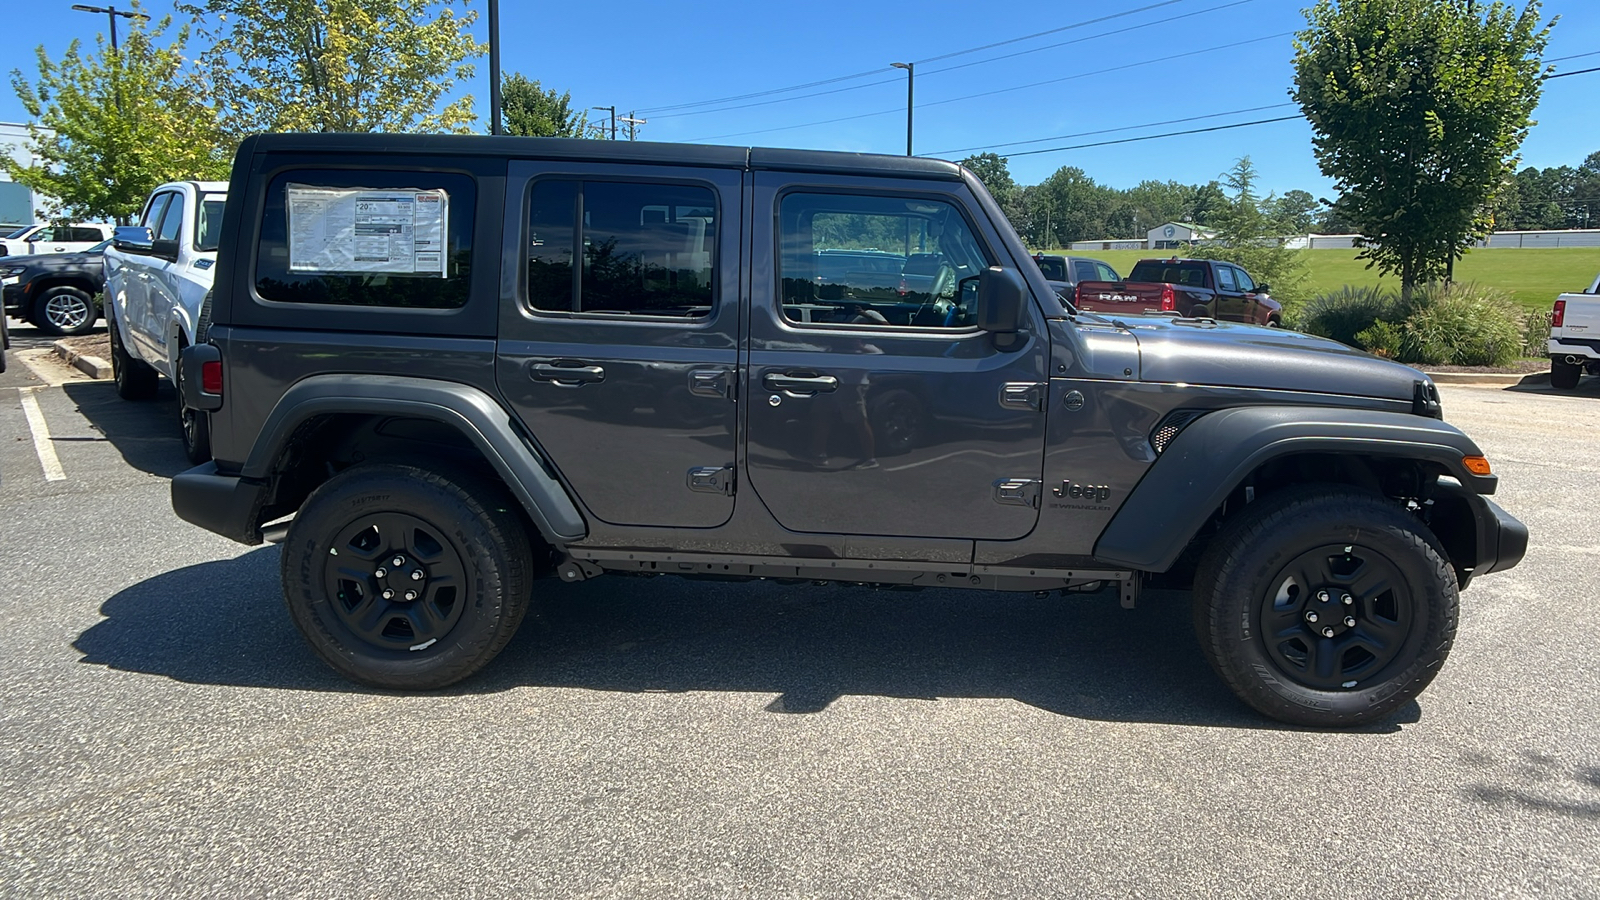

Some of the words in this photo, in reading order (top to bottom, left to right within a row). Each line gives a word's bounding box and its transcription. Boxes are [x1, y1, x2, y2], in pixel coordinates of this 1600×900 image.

[1098, 293, 1138, 302] RAM
[1052, 479, 1111, 503] Jeep
[1059, 503, 1111, 511] WRANGLER
[455, 529, 484, 608] NEXEN
